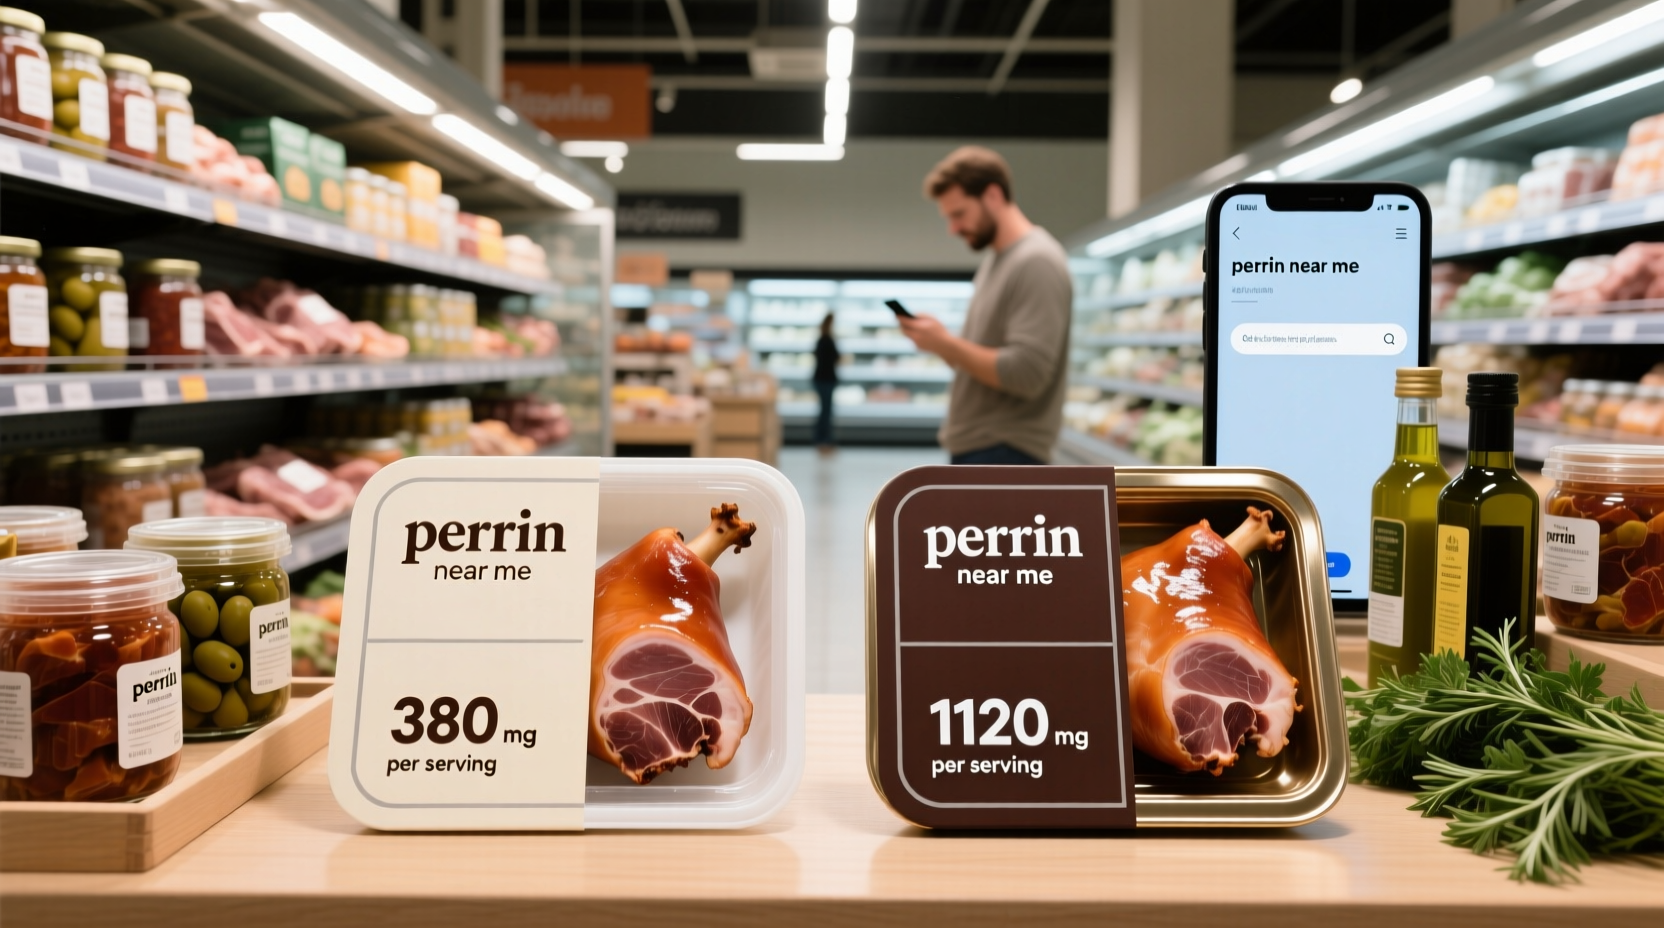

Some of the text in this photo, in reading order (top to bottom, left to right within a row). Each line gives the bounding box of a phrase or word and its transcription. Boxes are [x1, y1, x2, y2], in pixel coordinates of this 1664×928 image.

[1232, 257, 1360, 276] perrin near me
[401, 508, 567, 564] perrin
[923, 513, 1083, 569] perrin
[433, 564, 532, 581] near me
[957, 568, 1054, 585] near me
[390, 696, 537, 749] 380 mg
[929, 697, 1089, 751] 1120 mg
[386, 753, 497, 777] per serving
[931, 754, 1043, 779] per serving
